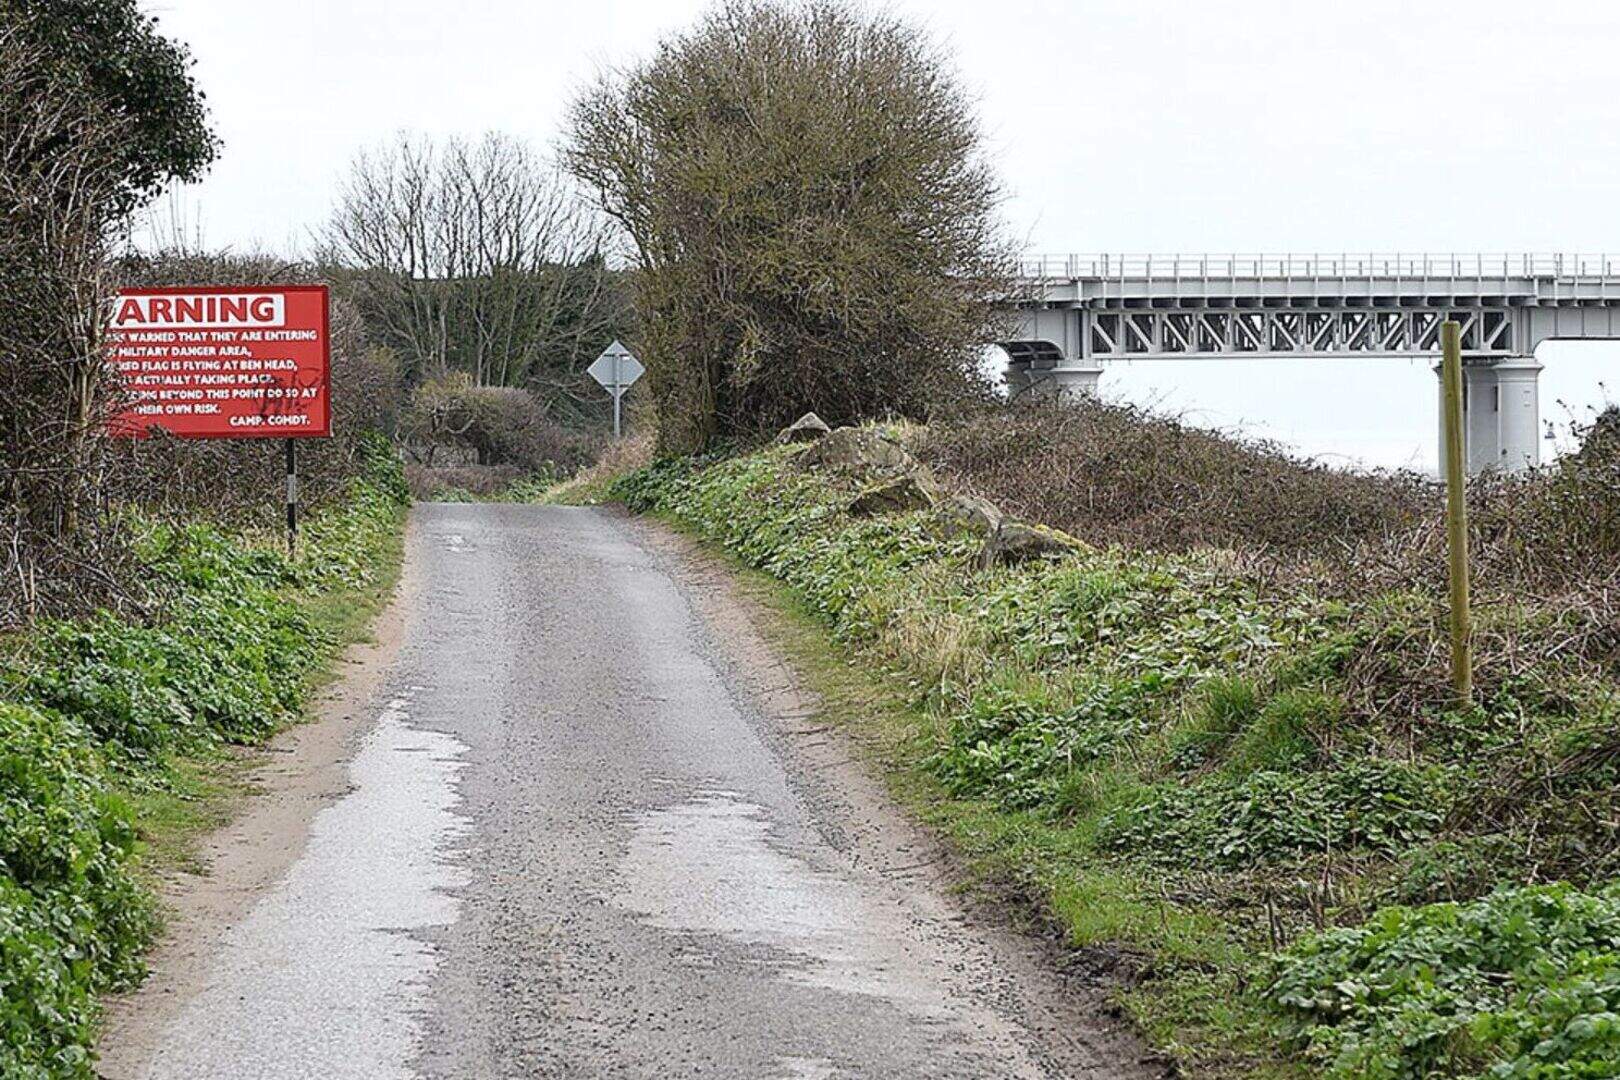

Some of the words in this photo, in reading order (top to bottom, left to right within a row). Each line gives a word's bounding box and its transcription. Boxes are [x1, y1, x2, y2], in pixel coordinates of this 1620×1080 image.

[116, 296, 274, 323] ARNING
[129, 332, 176, 342] WARNED
[178, 332, 208, 342] THAT
[211, 331, 238, 342] THEY
[241, 331, 262, 341] ARE
[264, 330, 317, 340] ENTERING
[118, 346, 168, 357] MILITARY
[171, 346, 216, 356] DANGER
[219, 345, 252, 357] AREA,
[142, 361, 169, 371] FLAG
[171, 361, 180, 370] IS
[183, 360, 220, 370] FLYING
[222, 360, 238, 370] AT
[264, 359, 297, 371] HEAD,
[135, 375, 190, 385] ACTUALLY
[194, 374, 235, 384] TAKING
[237, 373, 275, 384] PLACE.
[160, 389, 203, 400] BEYOND
[206, 389, 229, 399] THIS
[231, 388, 265, 399] POINT
[267, 388, 283, 398] DO
[285, 388, 299, 398] SO
[301, 387, 317, 398] AT
[165, 405, 192, 414] OWN
[194, 404, 222, 415] RISK.
[230, 416, 265, 426] CAMP.
[267, 415, 311, 425] COMDT.
